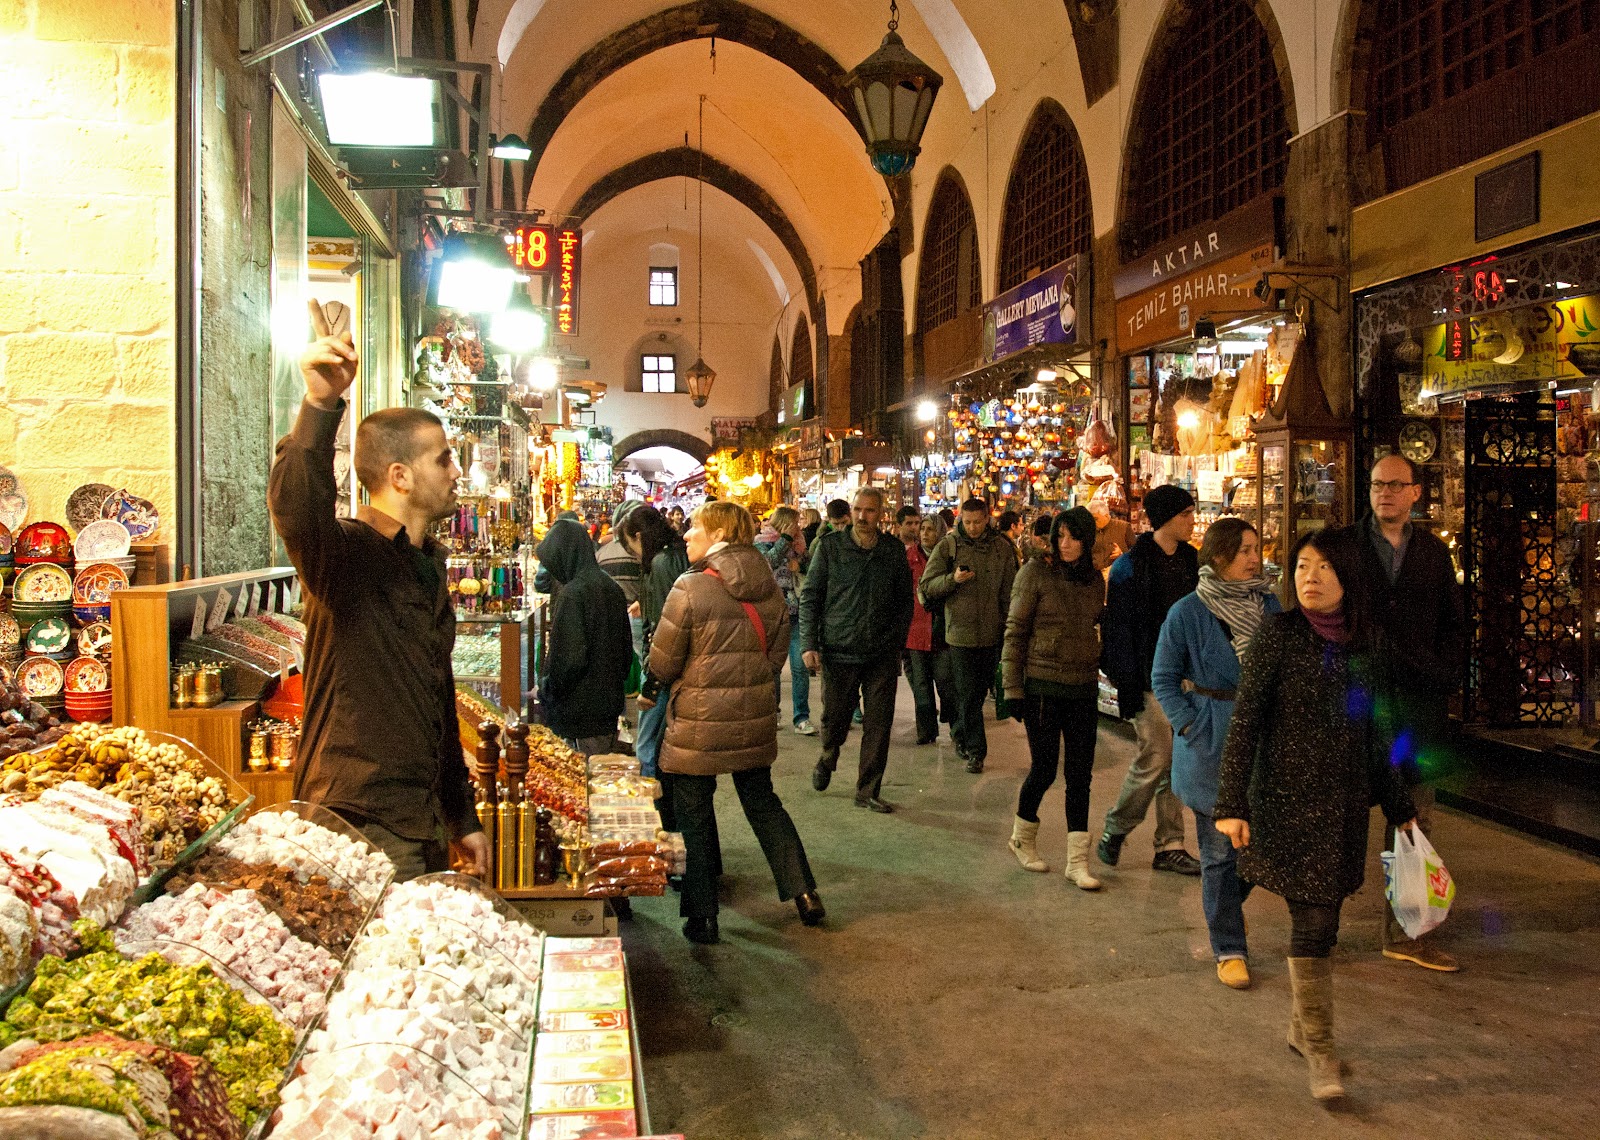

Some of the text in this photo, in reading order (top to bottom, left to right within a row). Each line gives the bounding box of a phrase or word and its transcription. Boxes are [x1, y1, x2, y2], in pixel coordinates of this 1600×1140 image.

[1152, 232, 1220, 277] AKTAR
[996, 300, 1025, 328] GALLERY
[1025, 284, 1059, 315] MEVLANA
[1172, 273, 1251, 307] BAHAR
[713, 420, 757, 429] MALATY
